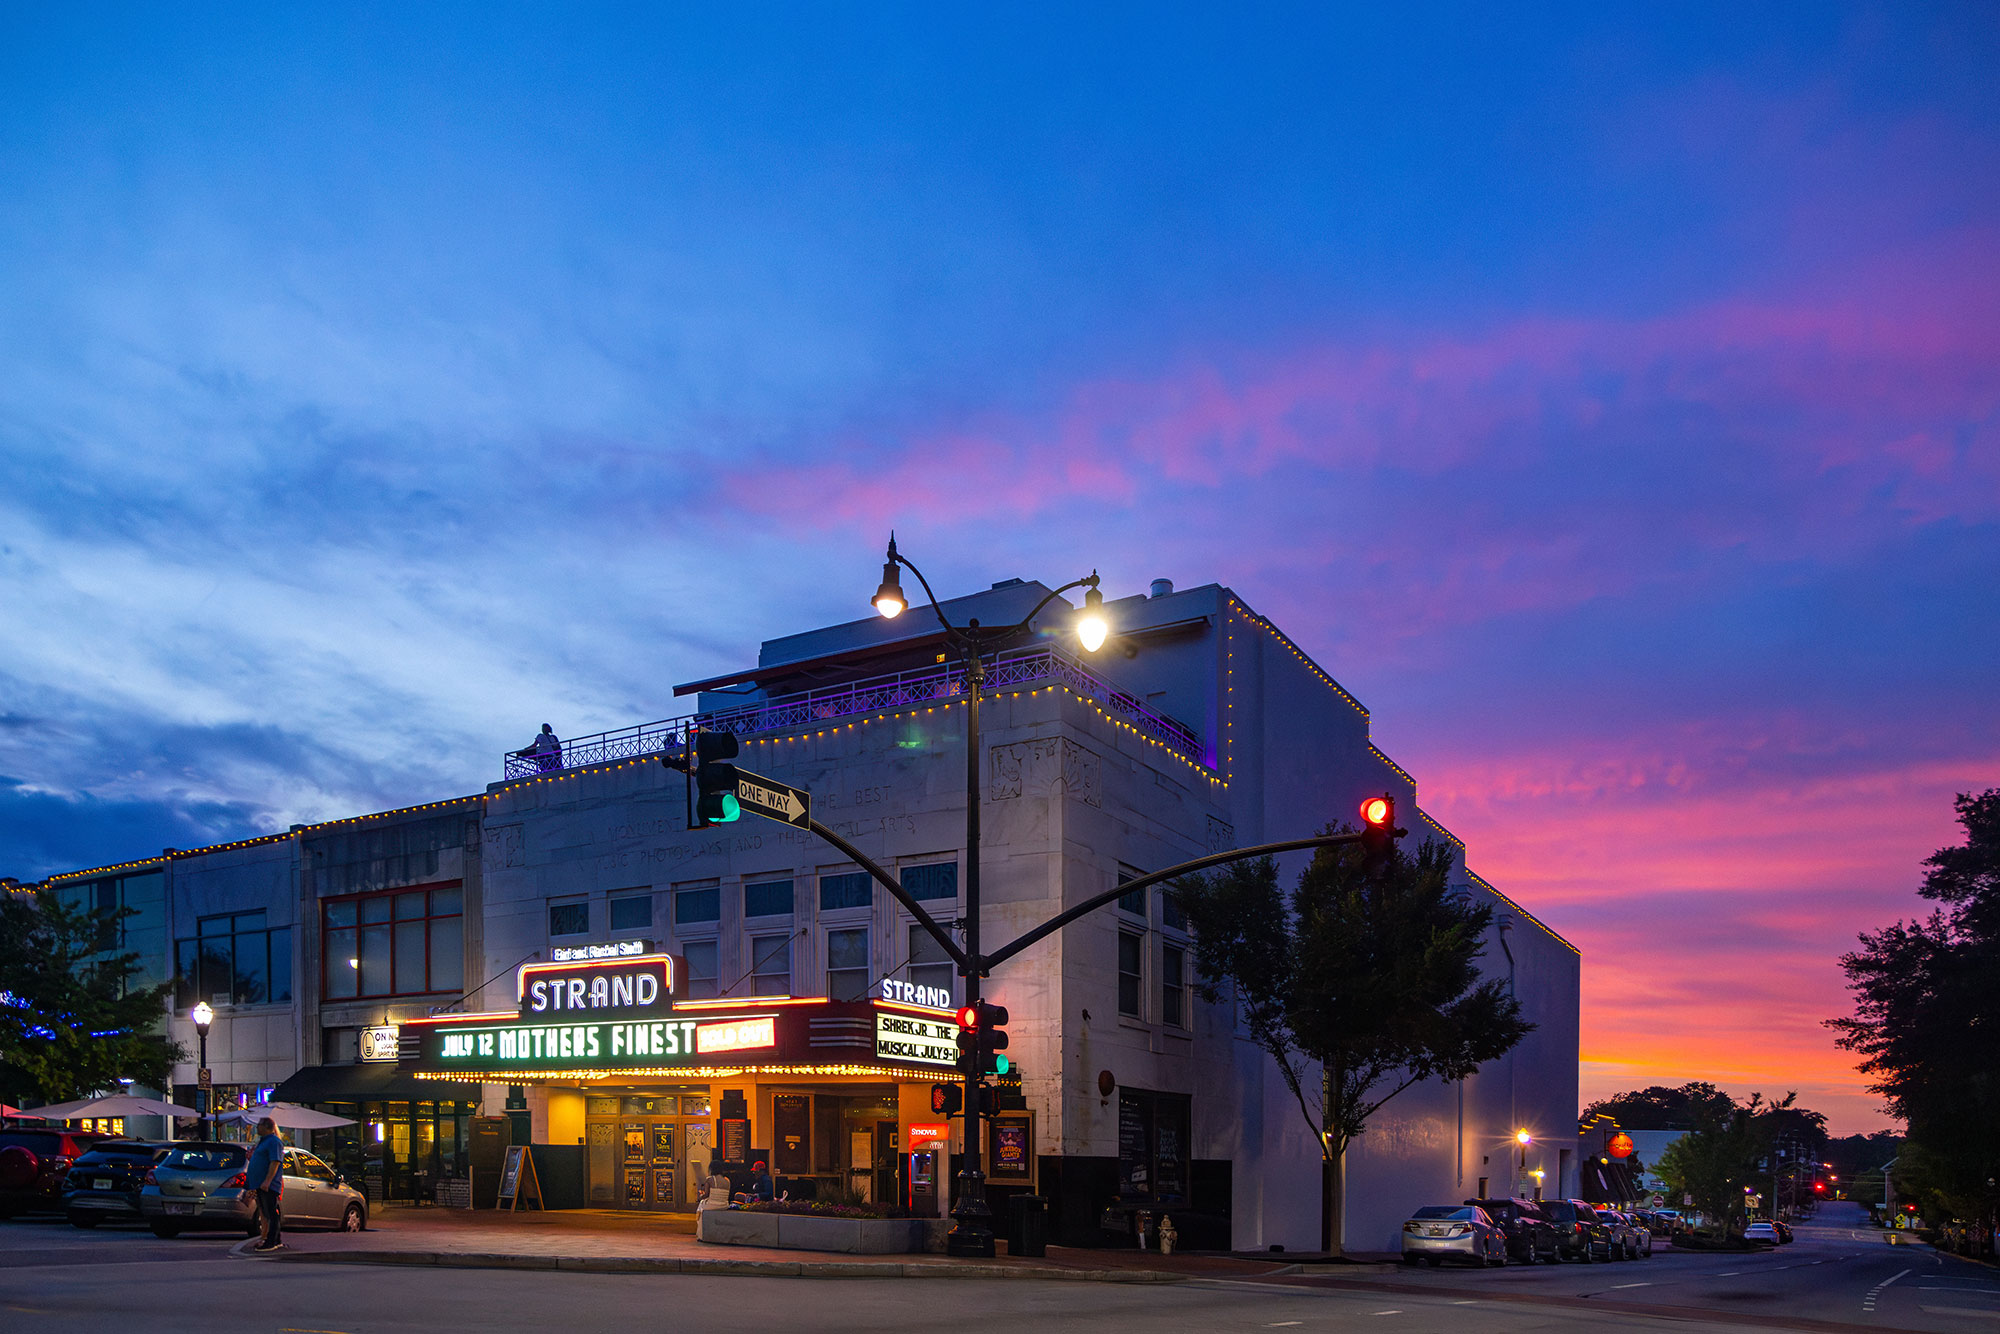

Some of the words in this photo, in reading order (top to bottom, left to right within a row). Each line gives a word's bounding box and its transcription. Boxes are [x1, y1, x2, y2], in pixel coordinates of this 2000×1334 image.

[740, 782, 763, 803] ONE
[767, 791, 791, 811] WAY
[855, 785, 892, 805] BEST
[735, 835, 763, 852] AND
[530, 972, 658, 1012] STRAND
[882, 978, 950, 1008] STRAND
[375, 1032, 387, 1041] ON
[738, 1024, 771, 1044] OUT
[882, 1018, 914, 1035] SHREK
[915, 1023, 928, 1036] JR
[936, 1025, 951, 1039] THE
[441, 1034, 473, 1057] JULY
[478, 1033, 493, 1056] 12
[499, 1026, 599, 1059] MOTHERS
[612, 1022, 696, 1056] FINEST
[878, 1040, 919, 1057] MUSICAL
[921, 1045, 943, 1060] JULY
